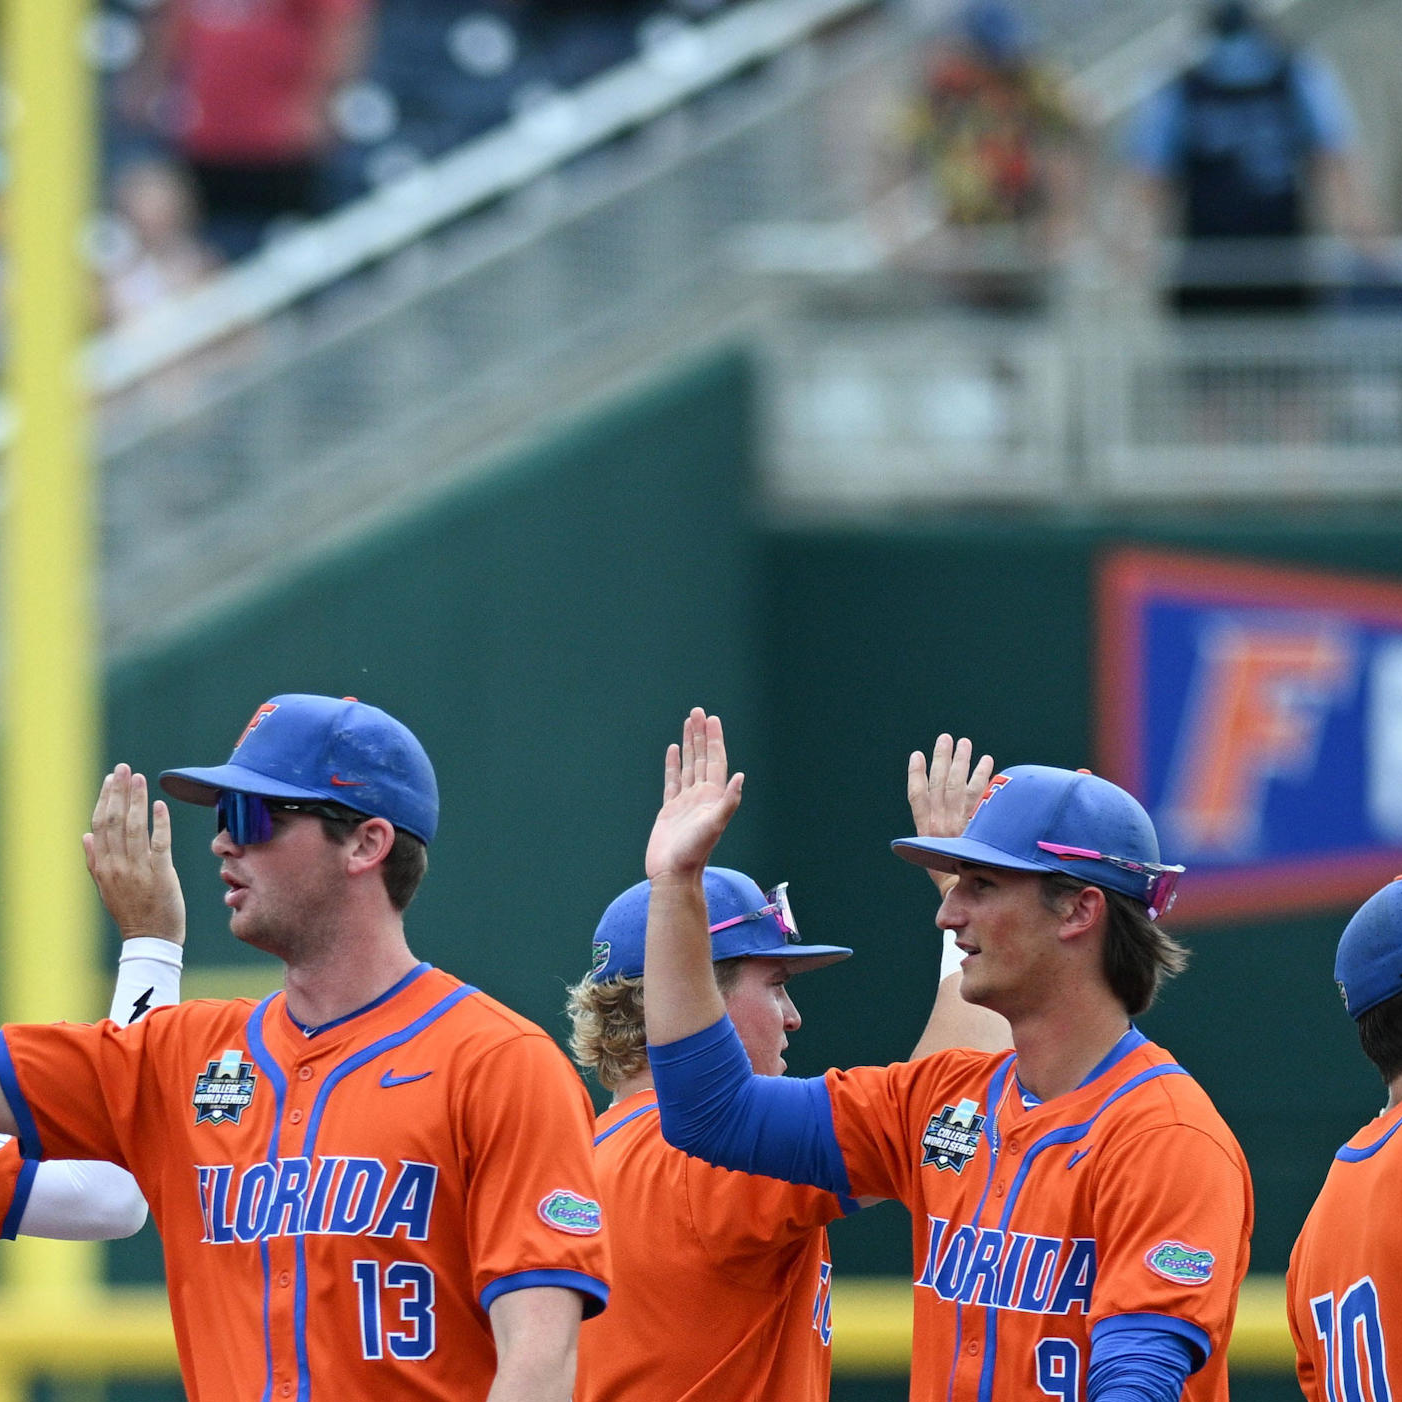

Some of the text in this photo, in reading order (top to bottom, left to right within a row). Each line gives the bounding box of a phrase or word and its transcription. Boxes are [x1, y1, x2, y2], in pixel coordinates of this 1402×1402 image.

[207, 1083, 240, 1094] COLLEGE
[194, 1094, 250, 1104] WORLD SERIES
[937, 1127, 971, 1143] COLLEGE
[924, 1134, 977, 1156] WORLD SERIES
[914, 1213, 1097, 1315] LORIDA
[353, 1259, 436, 1360] 13
